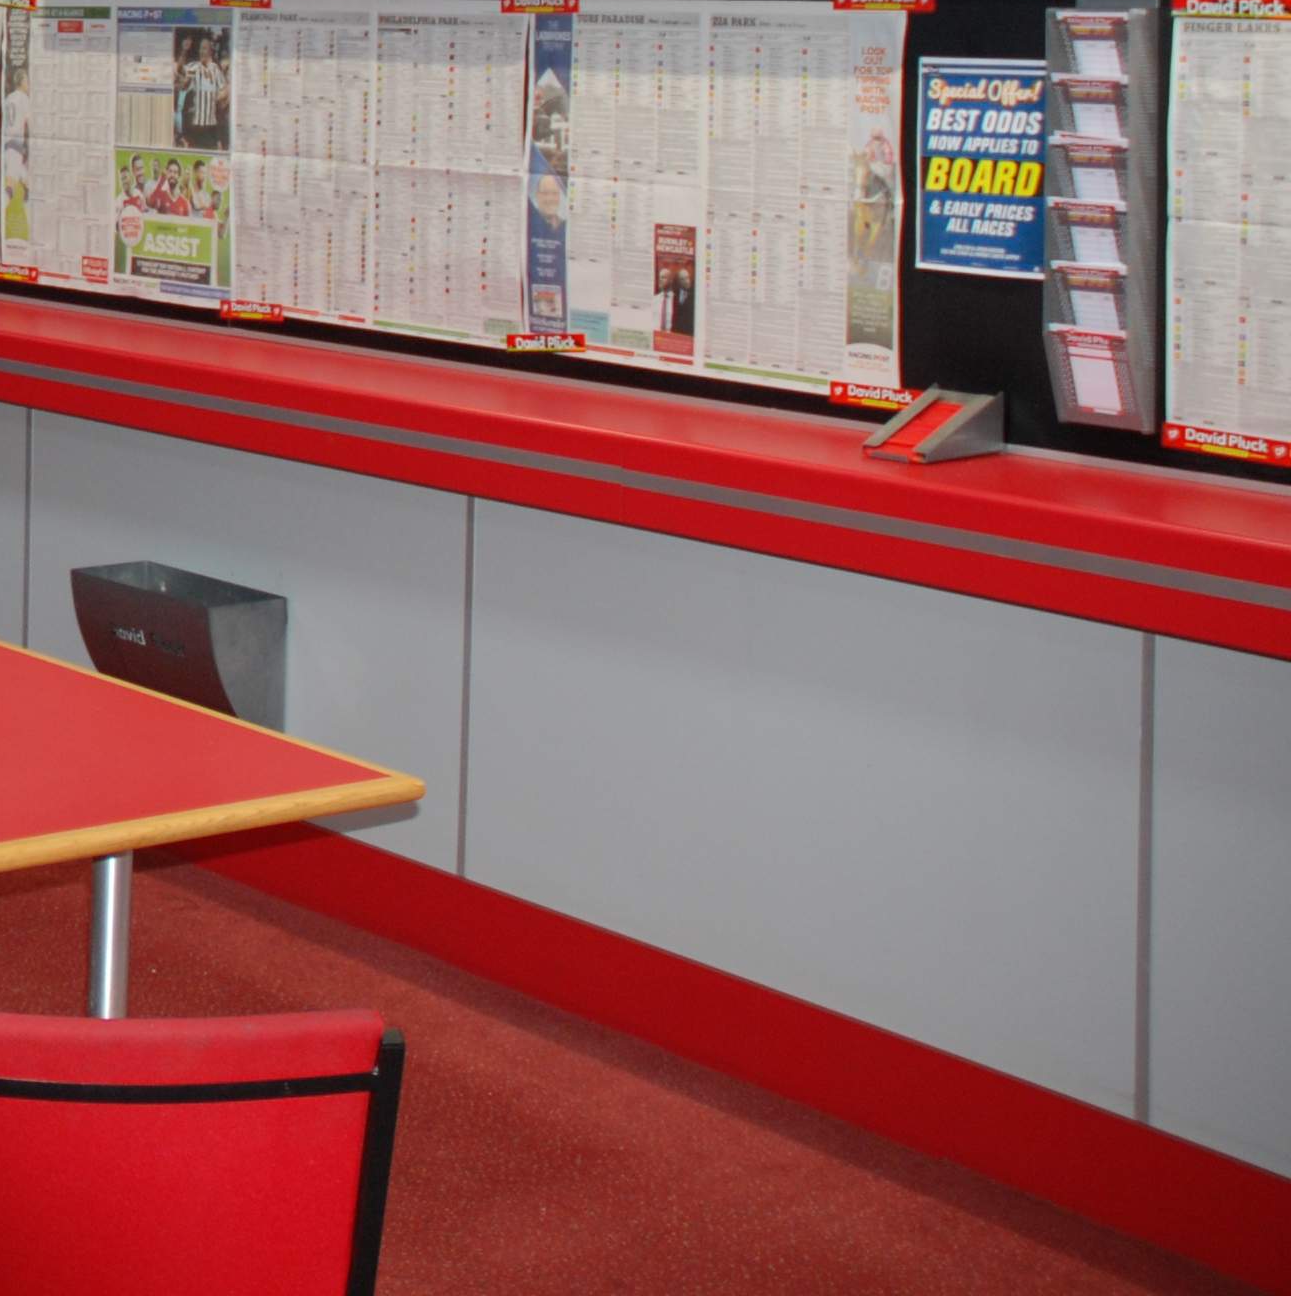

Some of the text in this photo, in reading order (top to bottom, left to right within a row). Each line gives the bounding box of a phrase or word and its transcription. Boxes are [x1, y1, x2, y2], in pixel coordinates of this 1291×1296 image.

[379, 15, 460, 27] PHILADELPHIA PARK
[602, 15, 646, 26] PARADISE
[731, 17, 757, 28] PARK
[1183, 22, 1281, 35] FINGER LAKES
[927, 77, 1043, 108] Special Offer!
[926, 108, 1044, 135] BEST ODDS
[927, 135, 1039, 155] NOW APPLIES TO
[925, 157, 1043, 197] BOARD
[929, 200, 1035, 222] & EARLY PRICES
[946, 217, 1016, 237] ALL RACES
[143, 232, 200, 258] ASSIST
[849, 352, 890, 363] RACING POST
[847, 384, 913, 404] David Pluck
[1185, 428, 1269, 453] David Pluck
